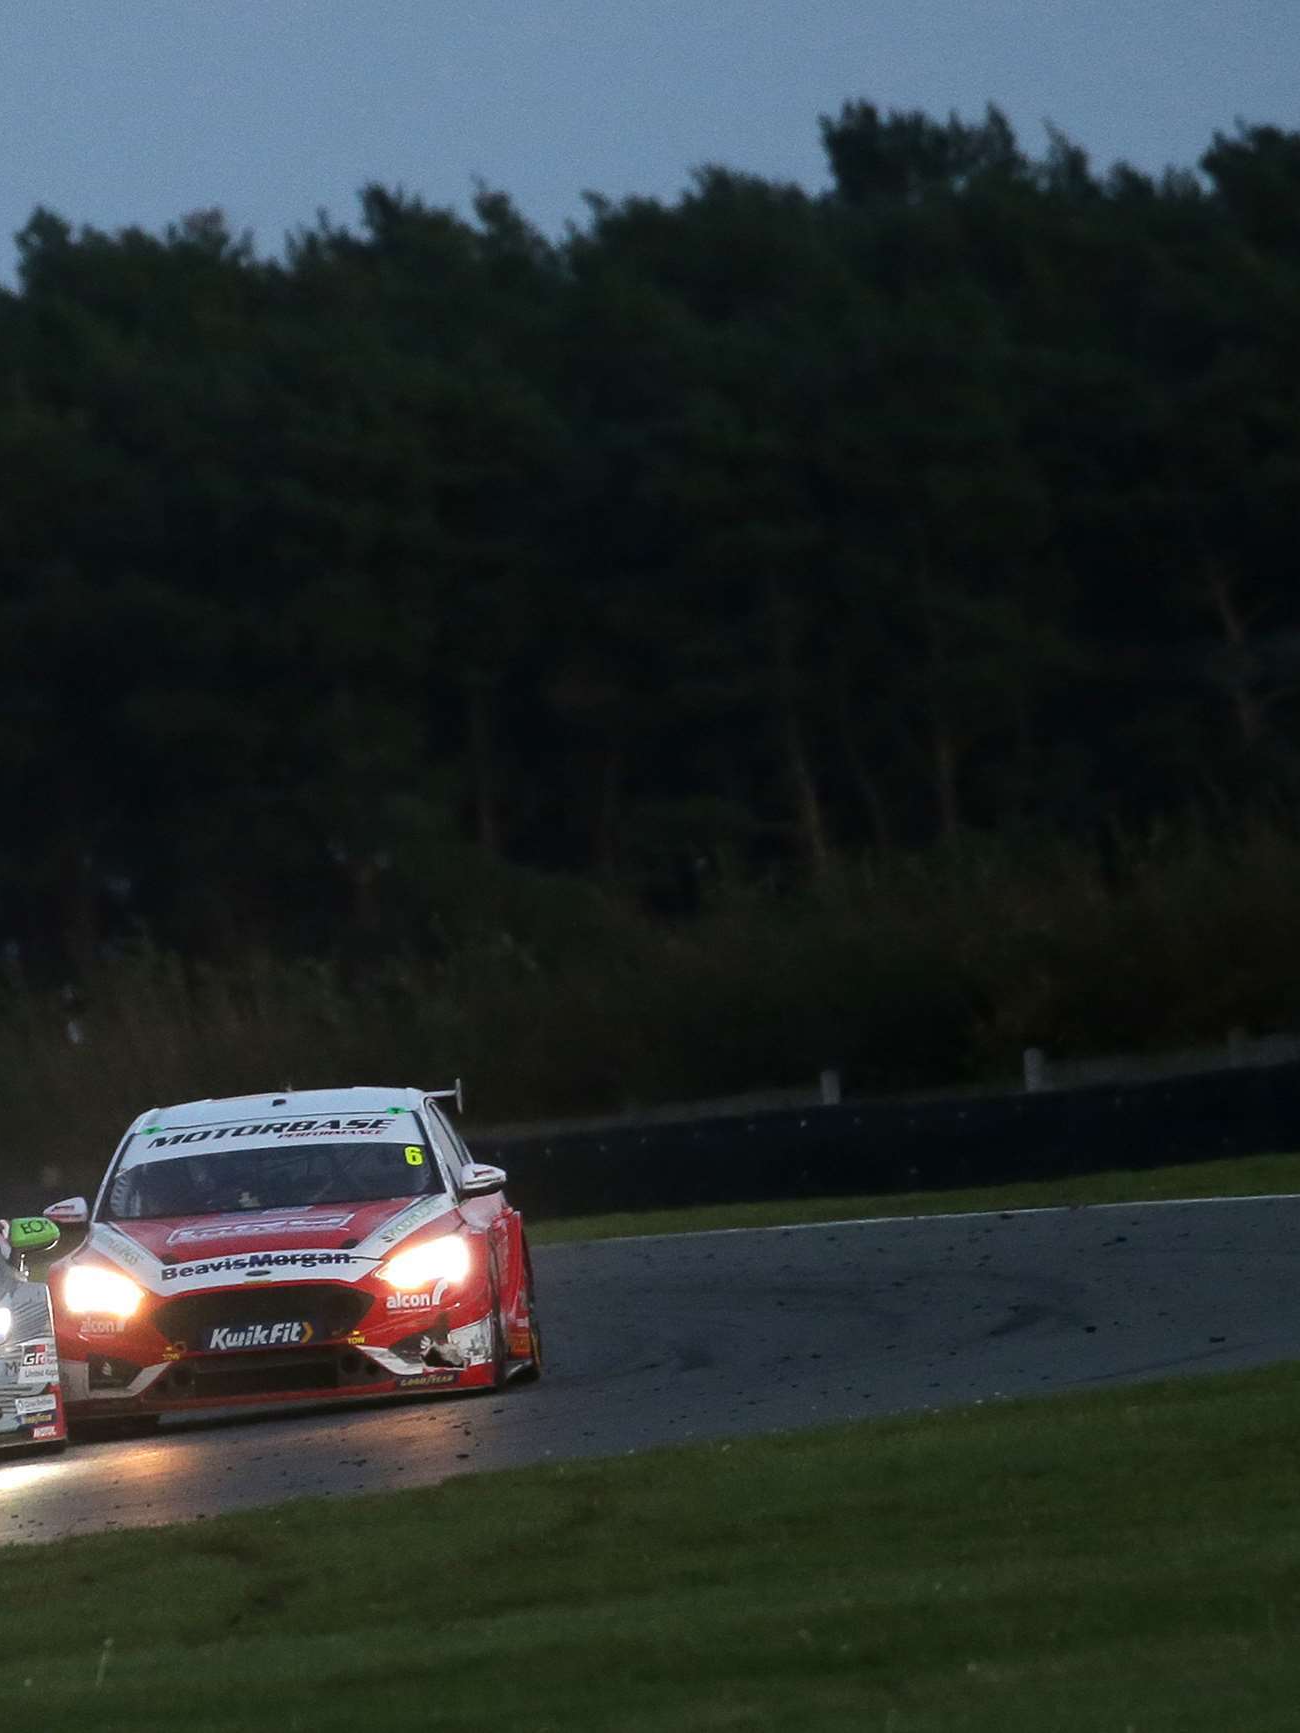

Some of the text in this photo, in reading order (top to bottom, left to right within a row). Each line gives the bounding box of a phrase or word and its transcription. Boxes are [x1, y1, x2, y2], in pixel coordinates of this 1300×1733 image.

[148, 1119, 395, 1149] MOTORBASE
[277, 1129, 384, 1140] PERFORMANCE
[404, 1146, 424, 1166] 6
[386, 1290, 430, 1310] alcon
